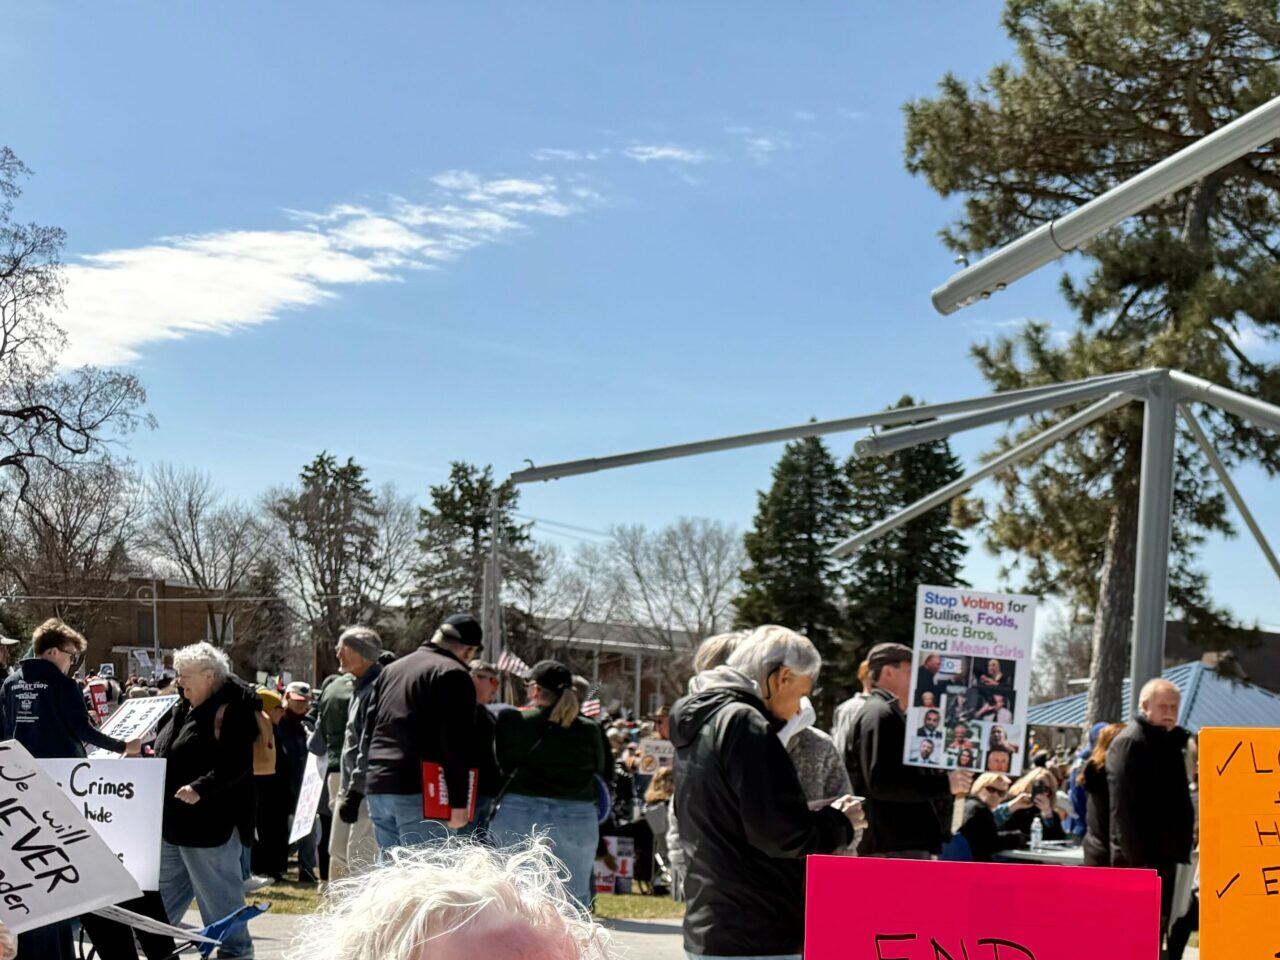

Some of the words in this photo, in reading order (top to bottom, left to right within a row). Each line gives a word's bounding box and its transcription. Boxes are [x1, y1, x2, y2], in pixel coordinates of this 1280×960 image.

[924, 591, 957, 608] Stop
[961, 596, 1004, 613] Voting
[1008, 600, 1028, 613] for
[924, 607, 974, 625] Bullies,
[976, 613, 1018, 629] Fools,
[922, 622, 958, 637] Toxic
[962, 626, 998, 642] Bros,
[921, 640, 947, 651] and
[951, 641, 989, 655] Mean
[993, 644, 1025, 659] Girls
[70, 762, 134, 799] Crimes
[83, 801, 113, 823] hide
[42, 810, 91, 845] will
